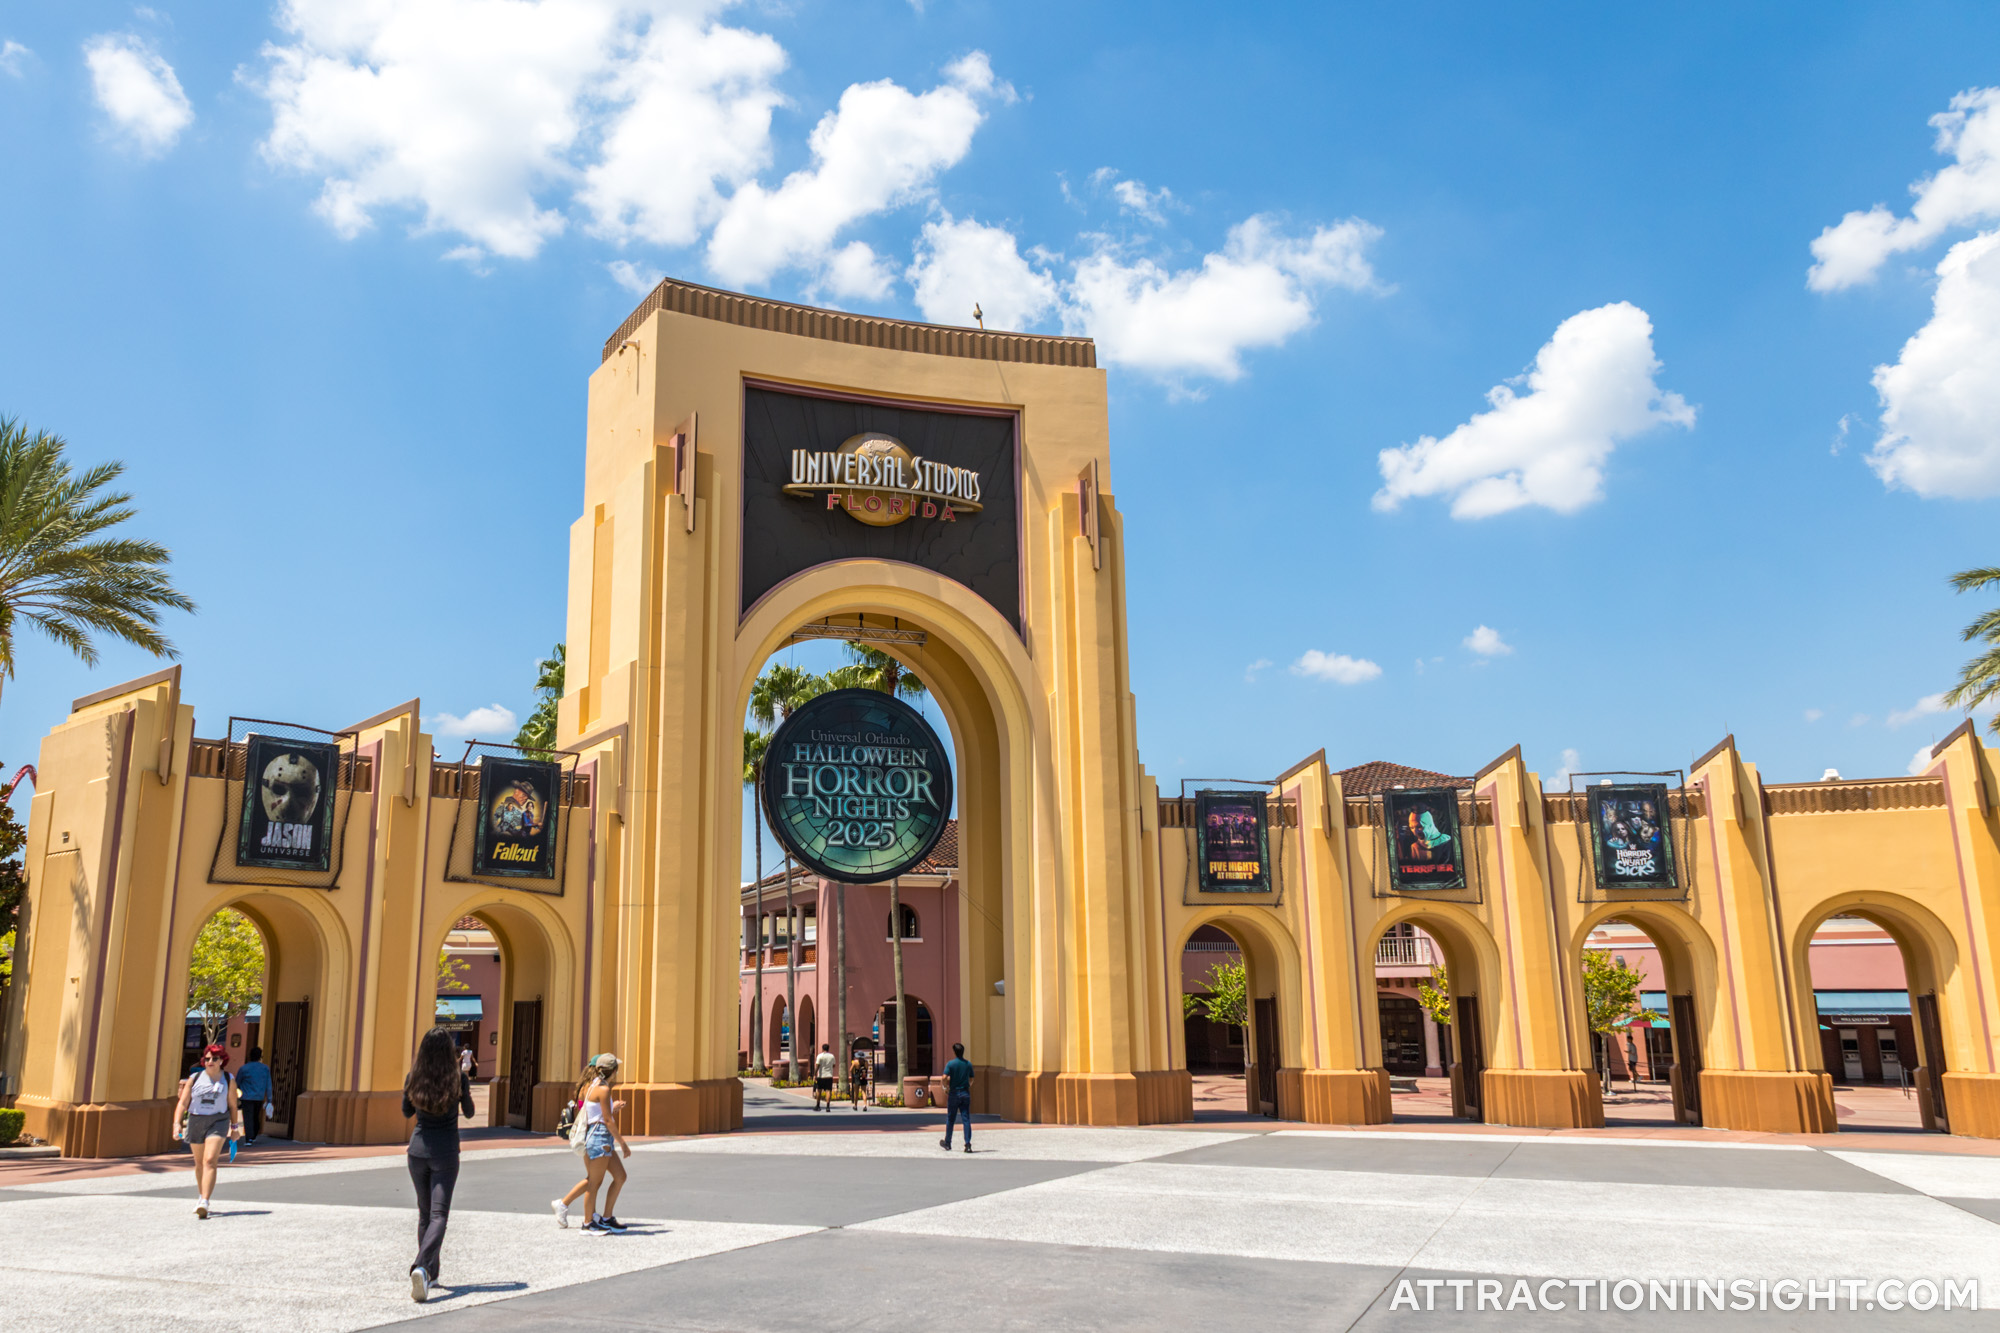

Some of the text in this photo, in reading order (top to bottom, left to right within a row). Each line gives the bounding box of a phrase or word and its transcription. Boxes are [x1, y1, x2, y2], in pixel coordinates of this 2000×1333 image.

[791, 448, 981, 502] UNIVERSAL STUDIOS
[826, 493, 957, 523] FLORIDA
[810, 729, 910, 746] Universal Orlando
[792, 742, 929, 768] HALLOWEEN
[781, 762, 941, 812] HORROR
[812, 796, 911, 821] NIGHTS
[260, 821, 313, 850] JASON
[826, 820, 897, 851] 2025
[260, 846, 311, 857] UN1V3RSE
[492, 842, 540, 863] Fallout
[1616, 849, 1653, 860] HORRORS
[1209, 861, 1260, 875] FIVE NIGHTS
[1216, 872, 1254, 880] AT FREDDY'S
[1399, 864, 1455, 874] TERRIFIER
[1615, 860, 1656, 876] SICKS
